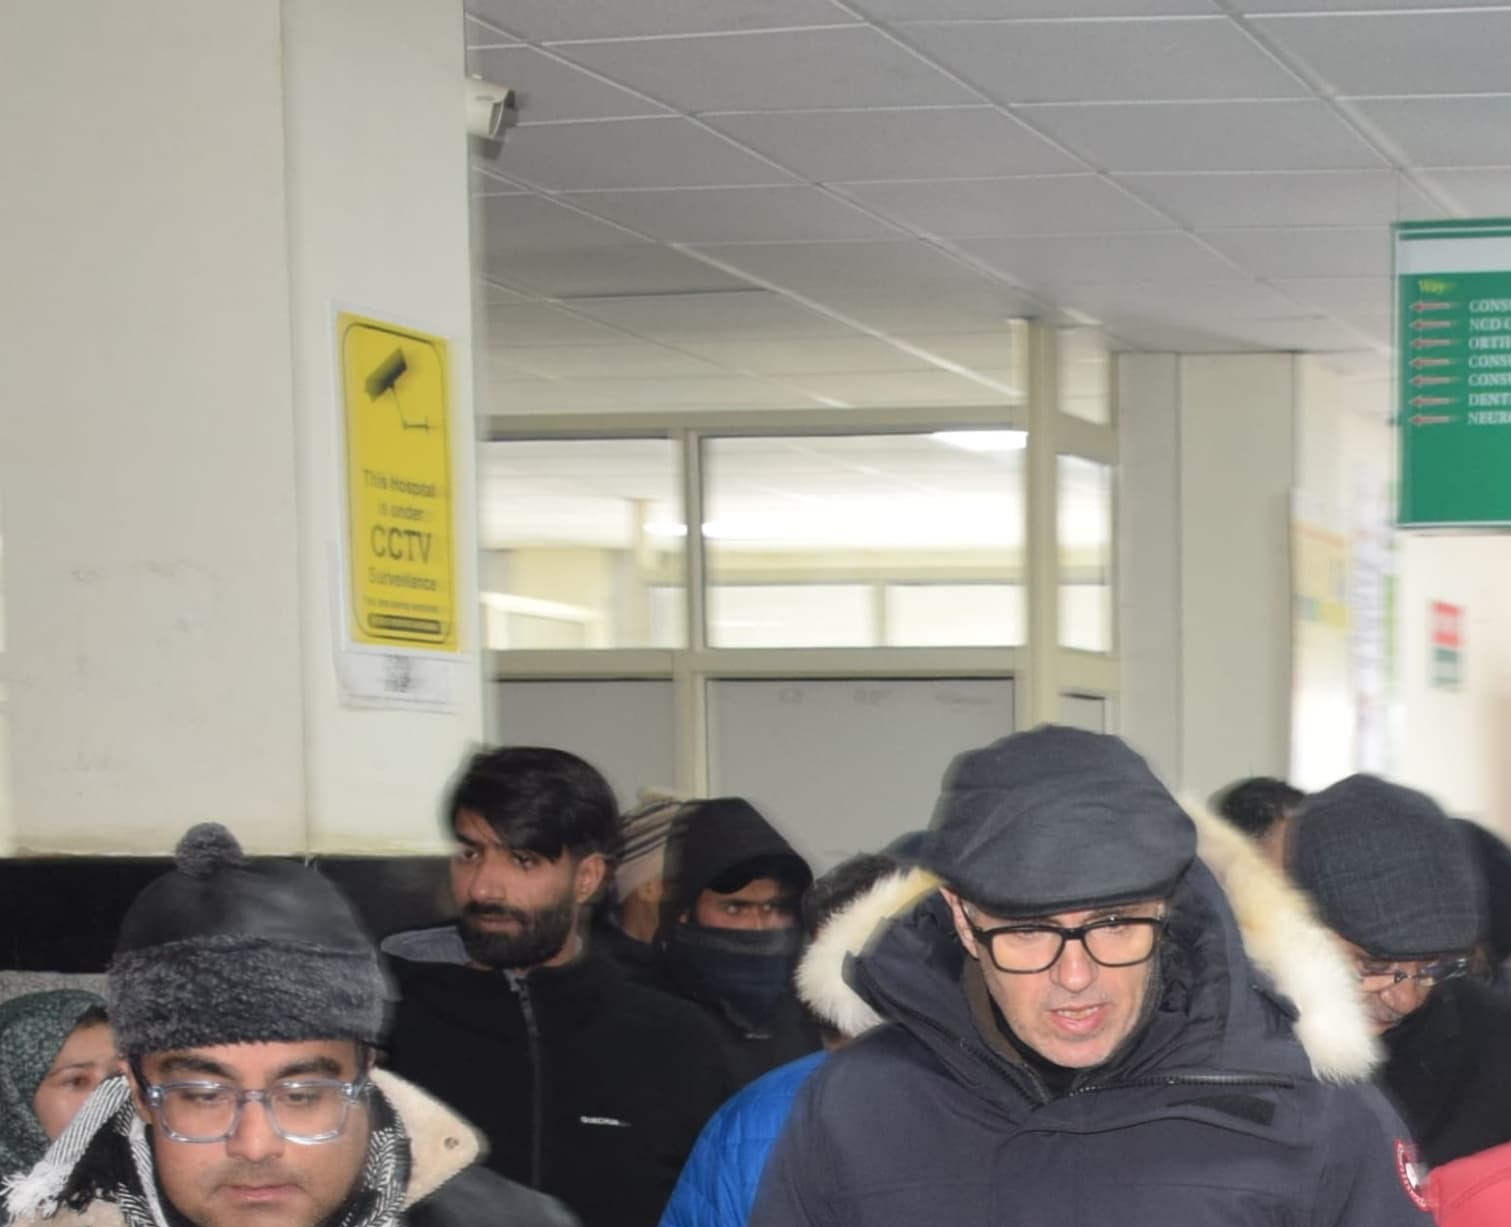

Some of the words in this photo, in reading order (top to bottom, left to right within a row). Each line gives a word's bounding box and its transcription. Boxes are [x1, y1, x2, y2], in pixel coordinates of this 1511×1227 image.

[1469, 317, 1501, 332] NCD
[362, 468, 387, 491] This
[389, 476, 437, 499] Hospital
[370, 524, 433, 564] CCTV
